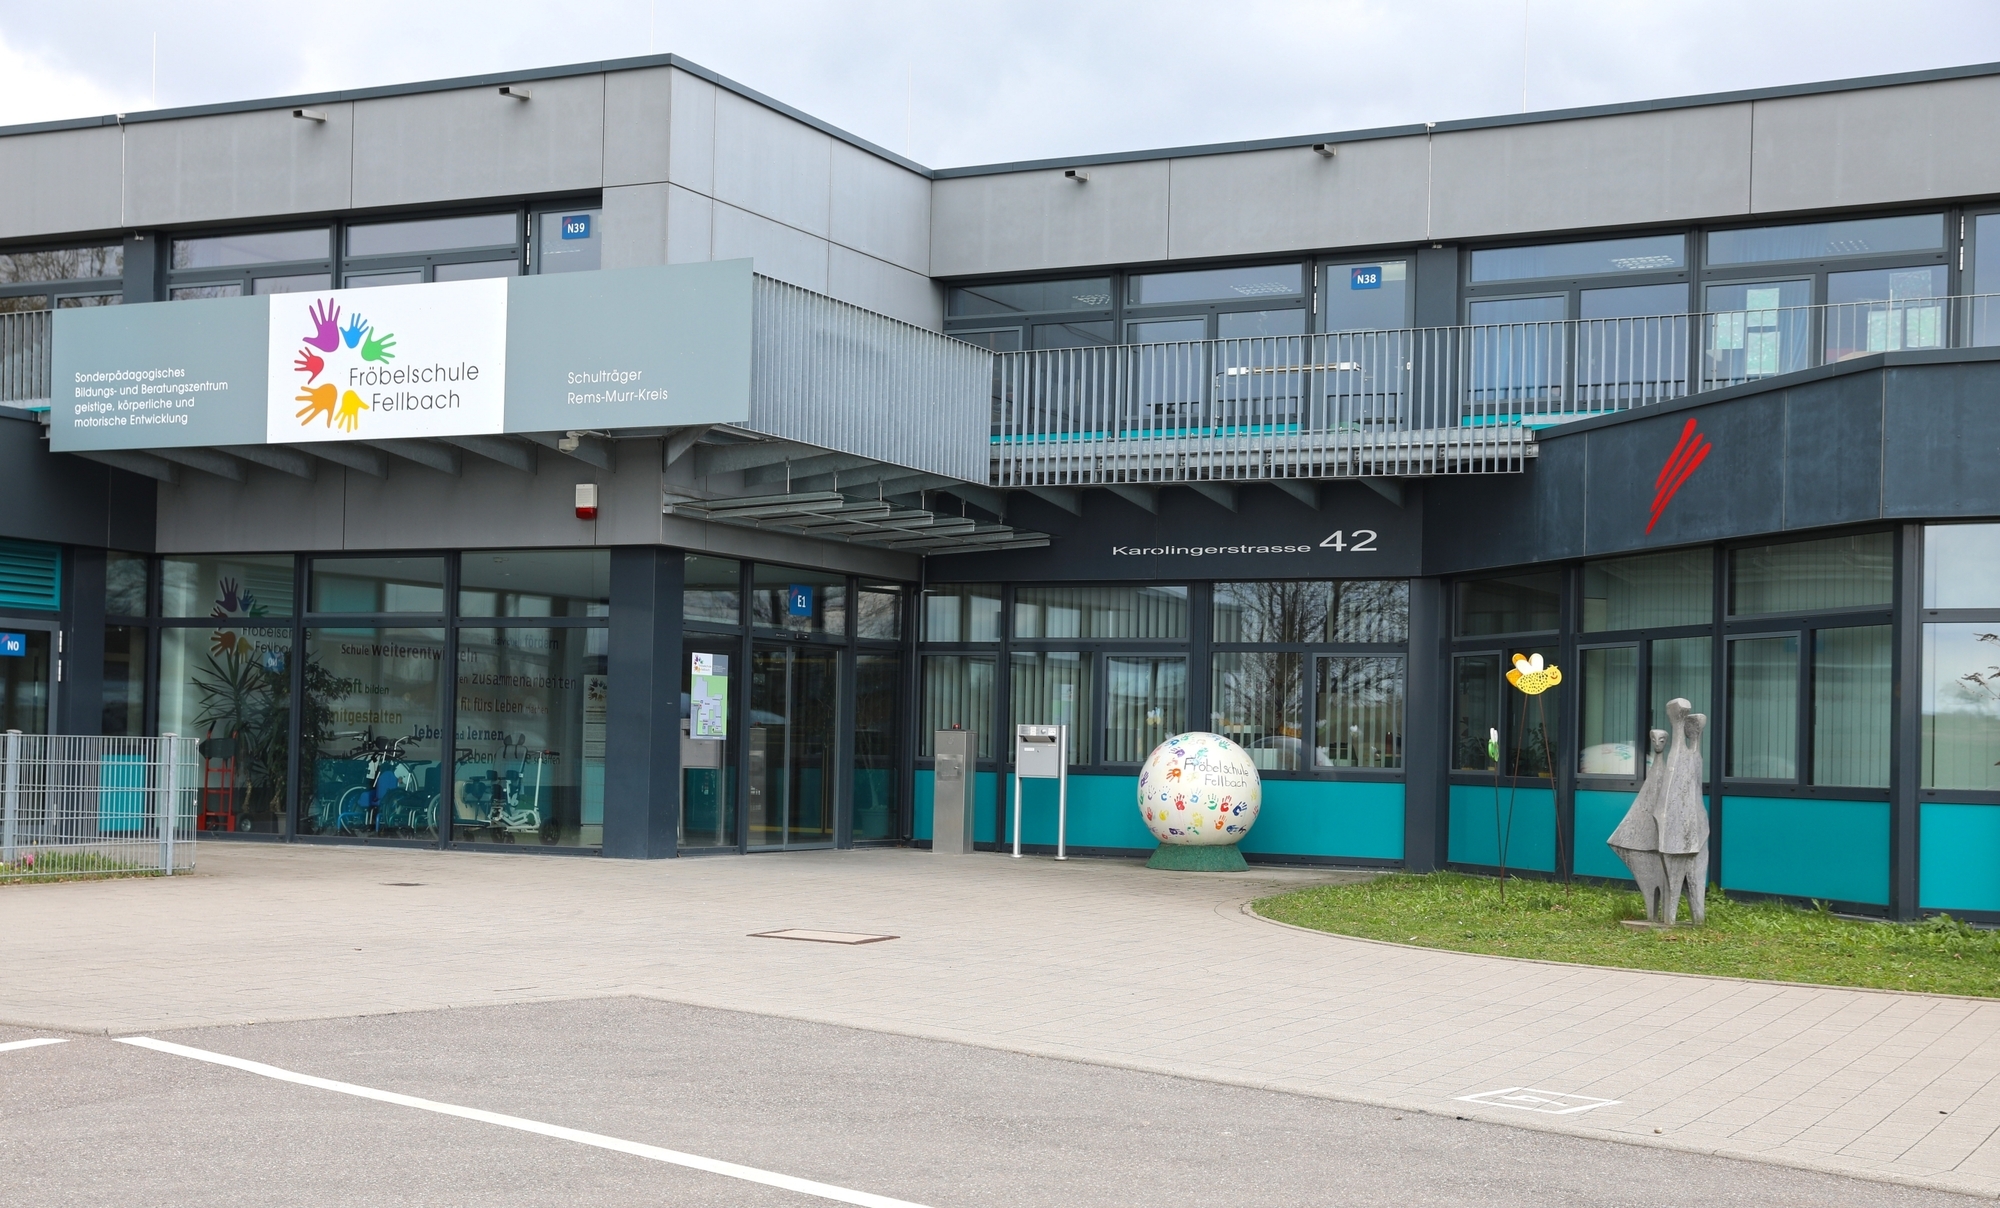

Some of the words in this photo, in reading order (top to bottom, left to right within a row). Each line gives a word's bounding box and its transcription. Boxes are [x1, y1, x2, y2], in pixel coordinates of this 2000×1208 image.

[567, 222, 585, 234] N39
[1357, 273, 1377, 285] N38
[74, 367, 186, 383] Sonderpädagogisches
[350, 361, 479, 387] Fröbelschule
[567, 369, 643, 385] Schulträger
[74, 386, 118, 399] Bildungs-
[119, 384, 139, 396] und
[141, 380, 229, 395] Beratungszentrum
[567, 387, 669, 405] Rems-Murr-Kreis
[74, 401, 115, 415] geistige,
[117, 398, 173, 412] körperliche
[175, 396, 195, 408] und
[372, 389, 461, 413] Fellbach
[74, 415, 127, 428] motorische
[129, 412, 188, 426] Entwicklung
[1112, 544, 1312, 557] Karolingerstrasse
[1319, 529, 1378, 552] 42
[797, 594, 807, 608] E1
[341, 644, 370, 656] Schule
[364, 684, 390, 695] bilden
[472, 673, 577, 690] zusammenarbeiten
[473, 697, 493, 713] fürs
[494, 699, 523, 714] Leben
[467, 726, 504, 742] lernen
[1183, 756, 1250, 777] Fröbelschule
[1204, 773, 1248, 788] Fellbach
